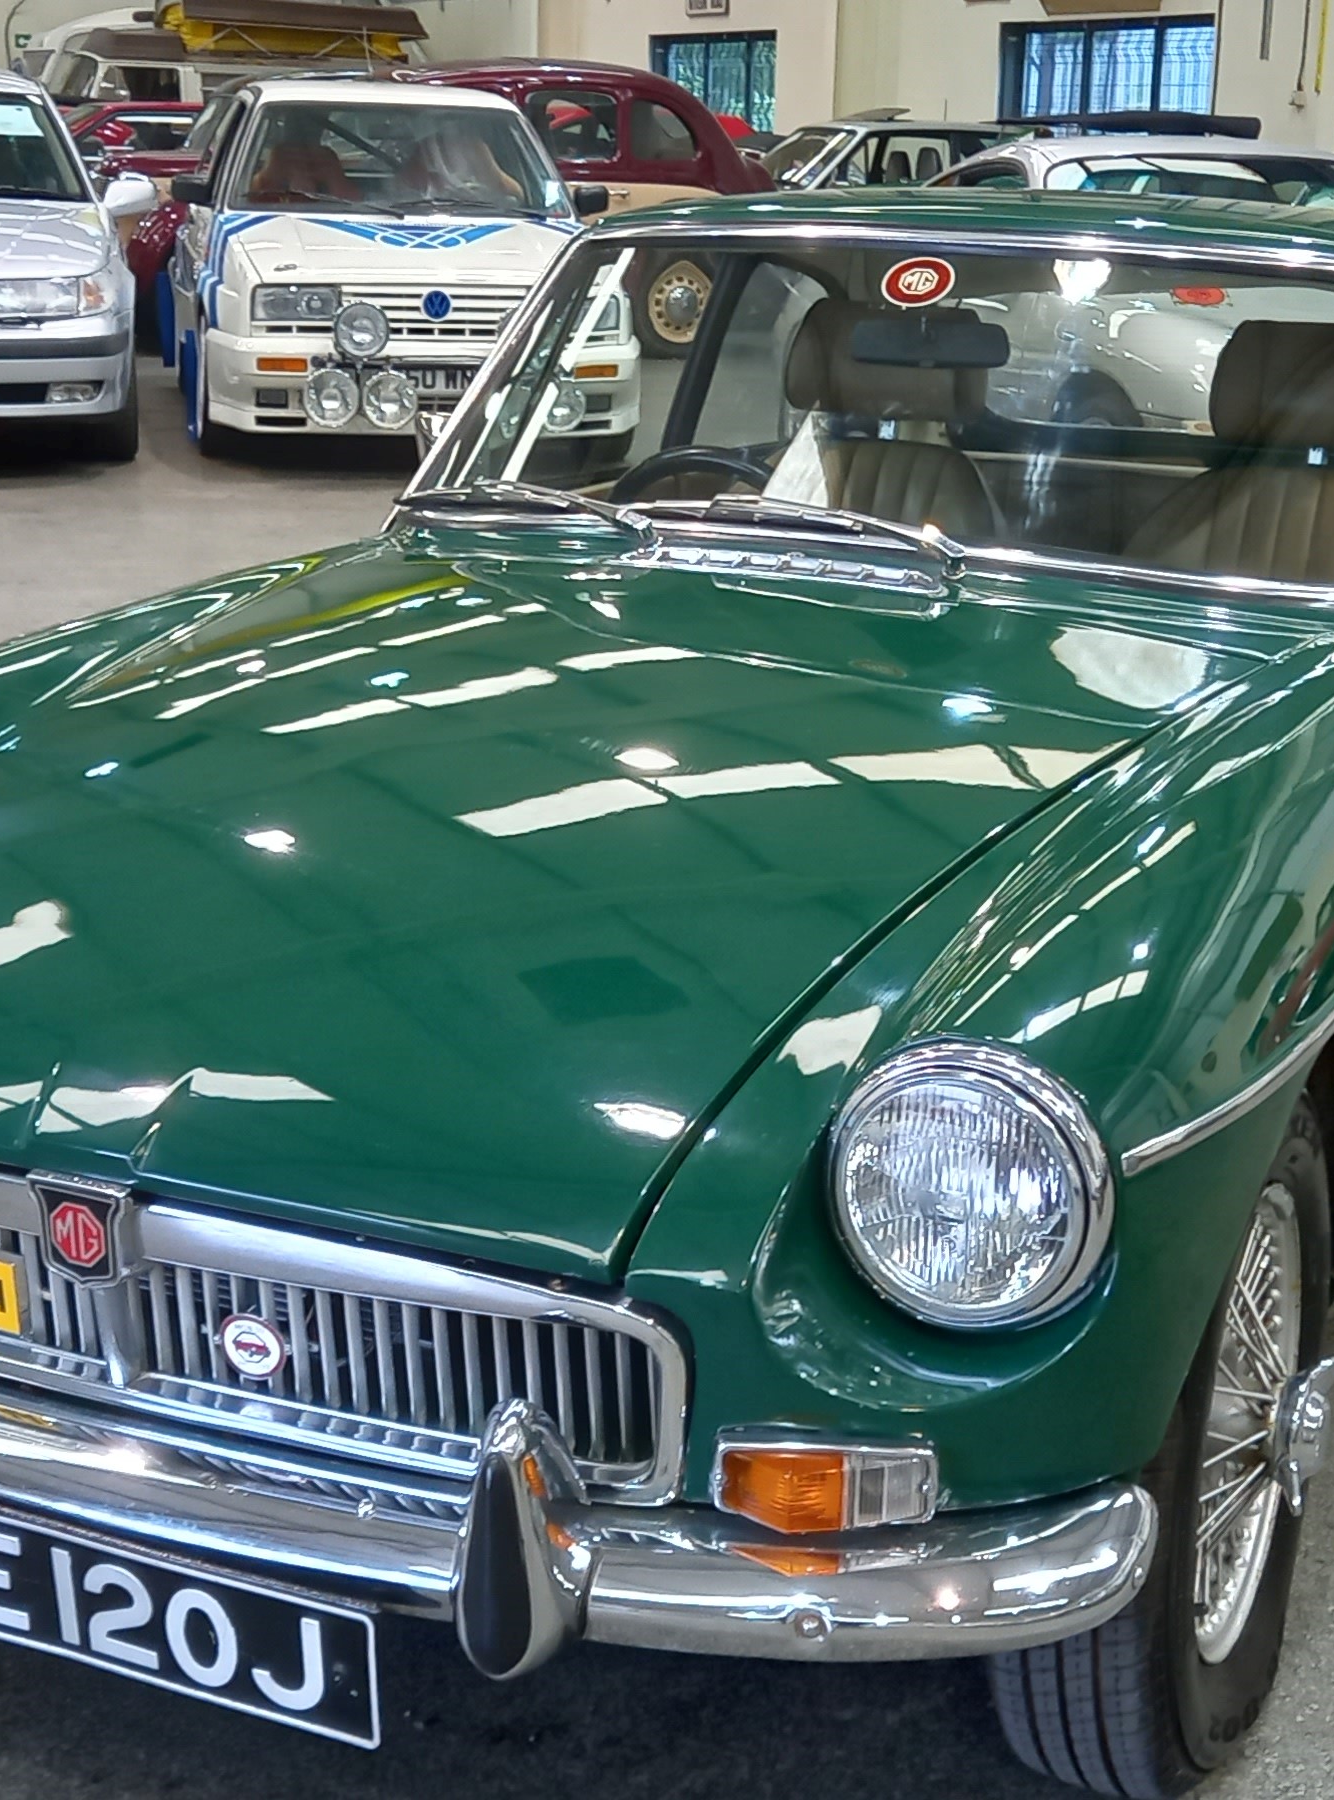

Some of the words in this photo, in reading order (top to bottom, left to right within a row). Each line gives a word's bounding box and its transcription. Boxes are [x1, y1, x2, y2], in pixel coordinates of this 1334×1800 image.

[903, 271, 935, 291] MG
[55, 1209, 99, 1260] MG
[50, 1546, 325, 1711] 120J
